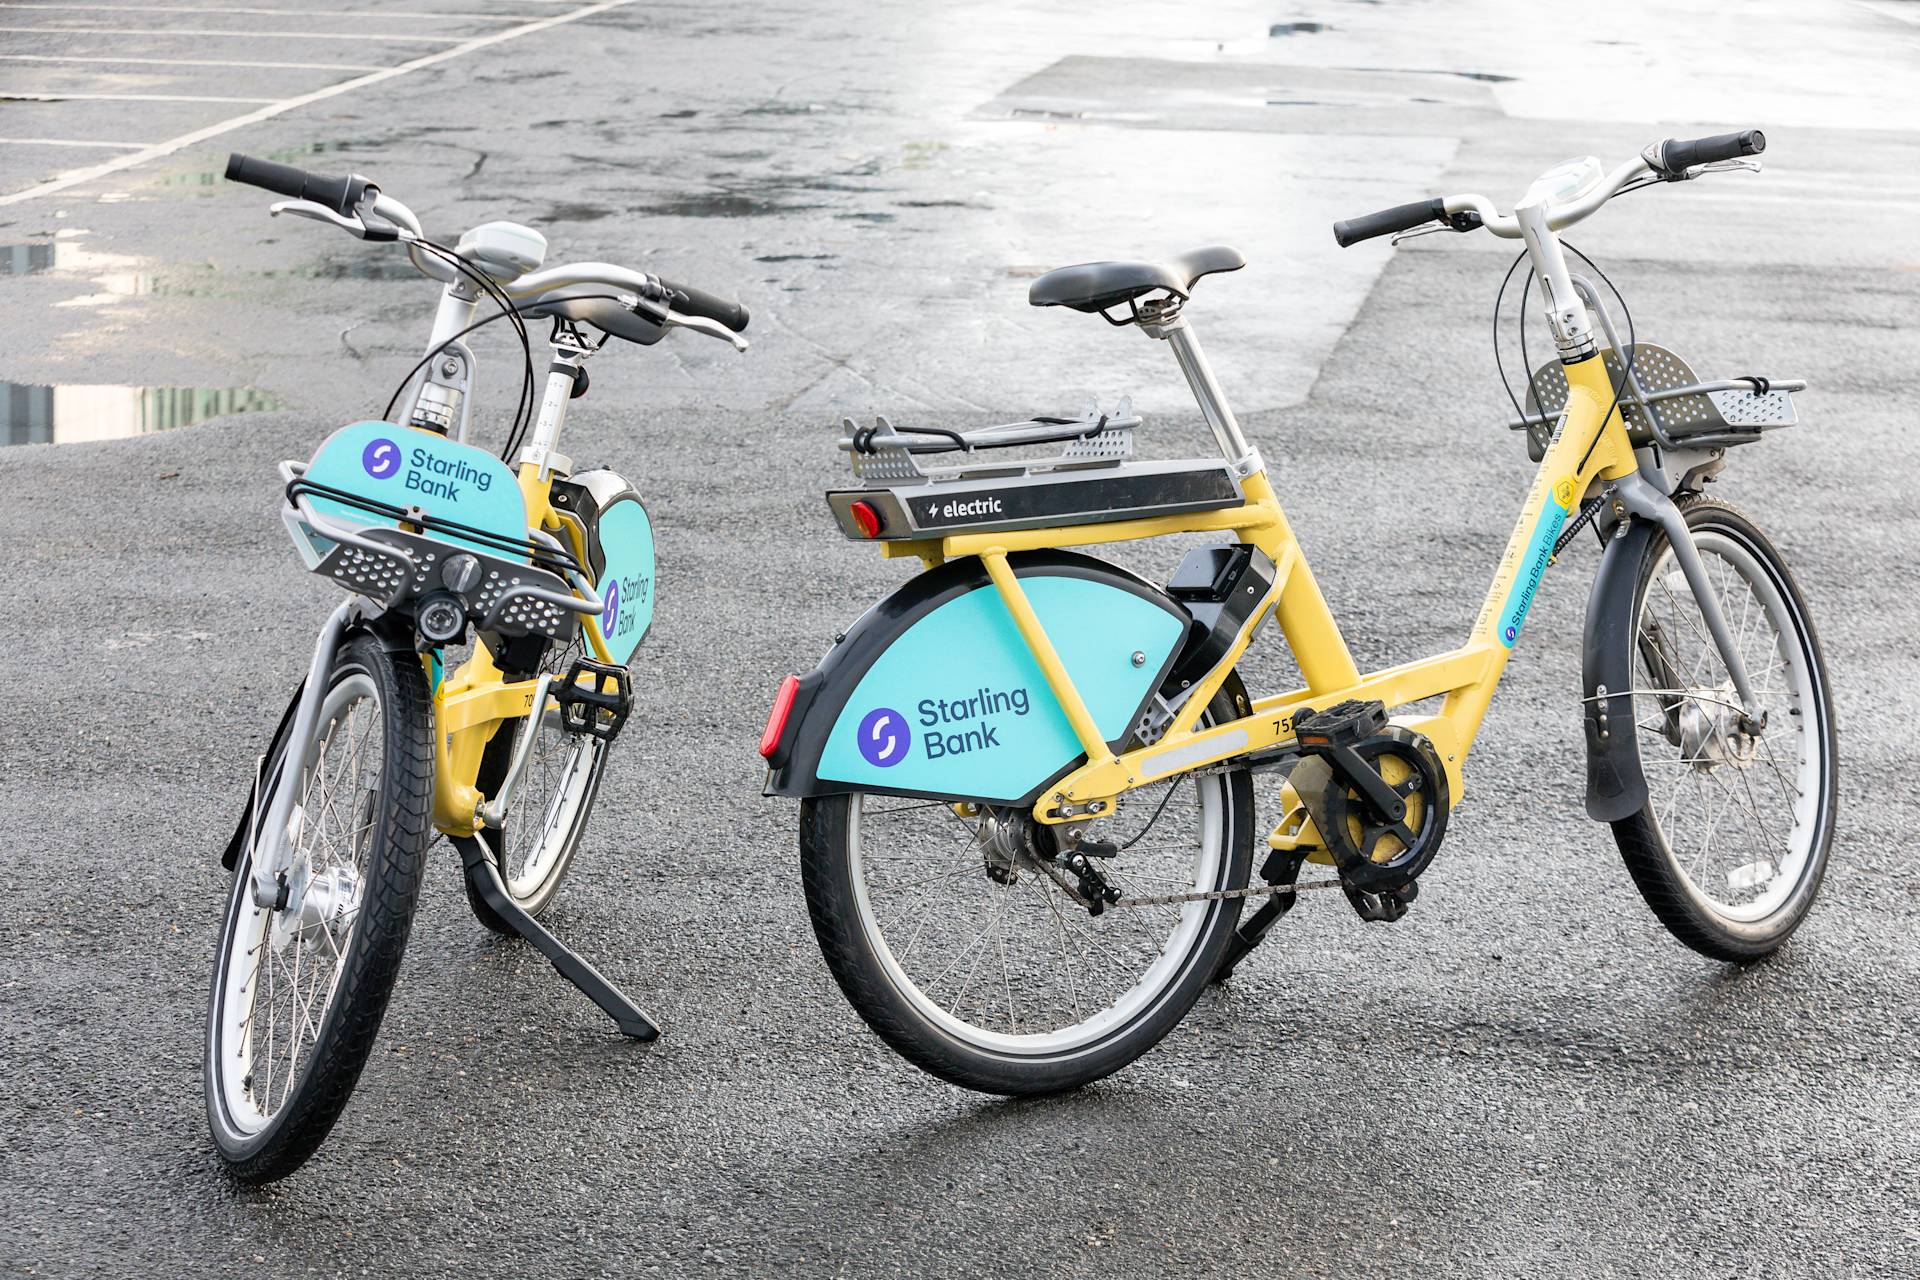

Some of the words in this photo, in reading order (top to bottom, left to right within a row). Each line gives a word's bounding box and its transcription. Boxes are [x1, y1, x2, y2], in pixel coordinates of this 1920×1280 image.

[411, 448, 492, 491] Starling
[405, 470, 460, 502] Bank
[943, 497, 1002, 518] electric
[1512, 578, 1537, 626] Starling
[1531, 545, 1549, 581] Bank
[1543, 513, 1562, 546] Bikes
[622, 572, 648, 604] Starling
[618, 606, 636, 636] Bank
[524, 693, 535, 708] 70
[918, 688, 1030, 727] Starling
[924, 721, 1001, 759] Bank
